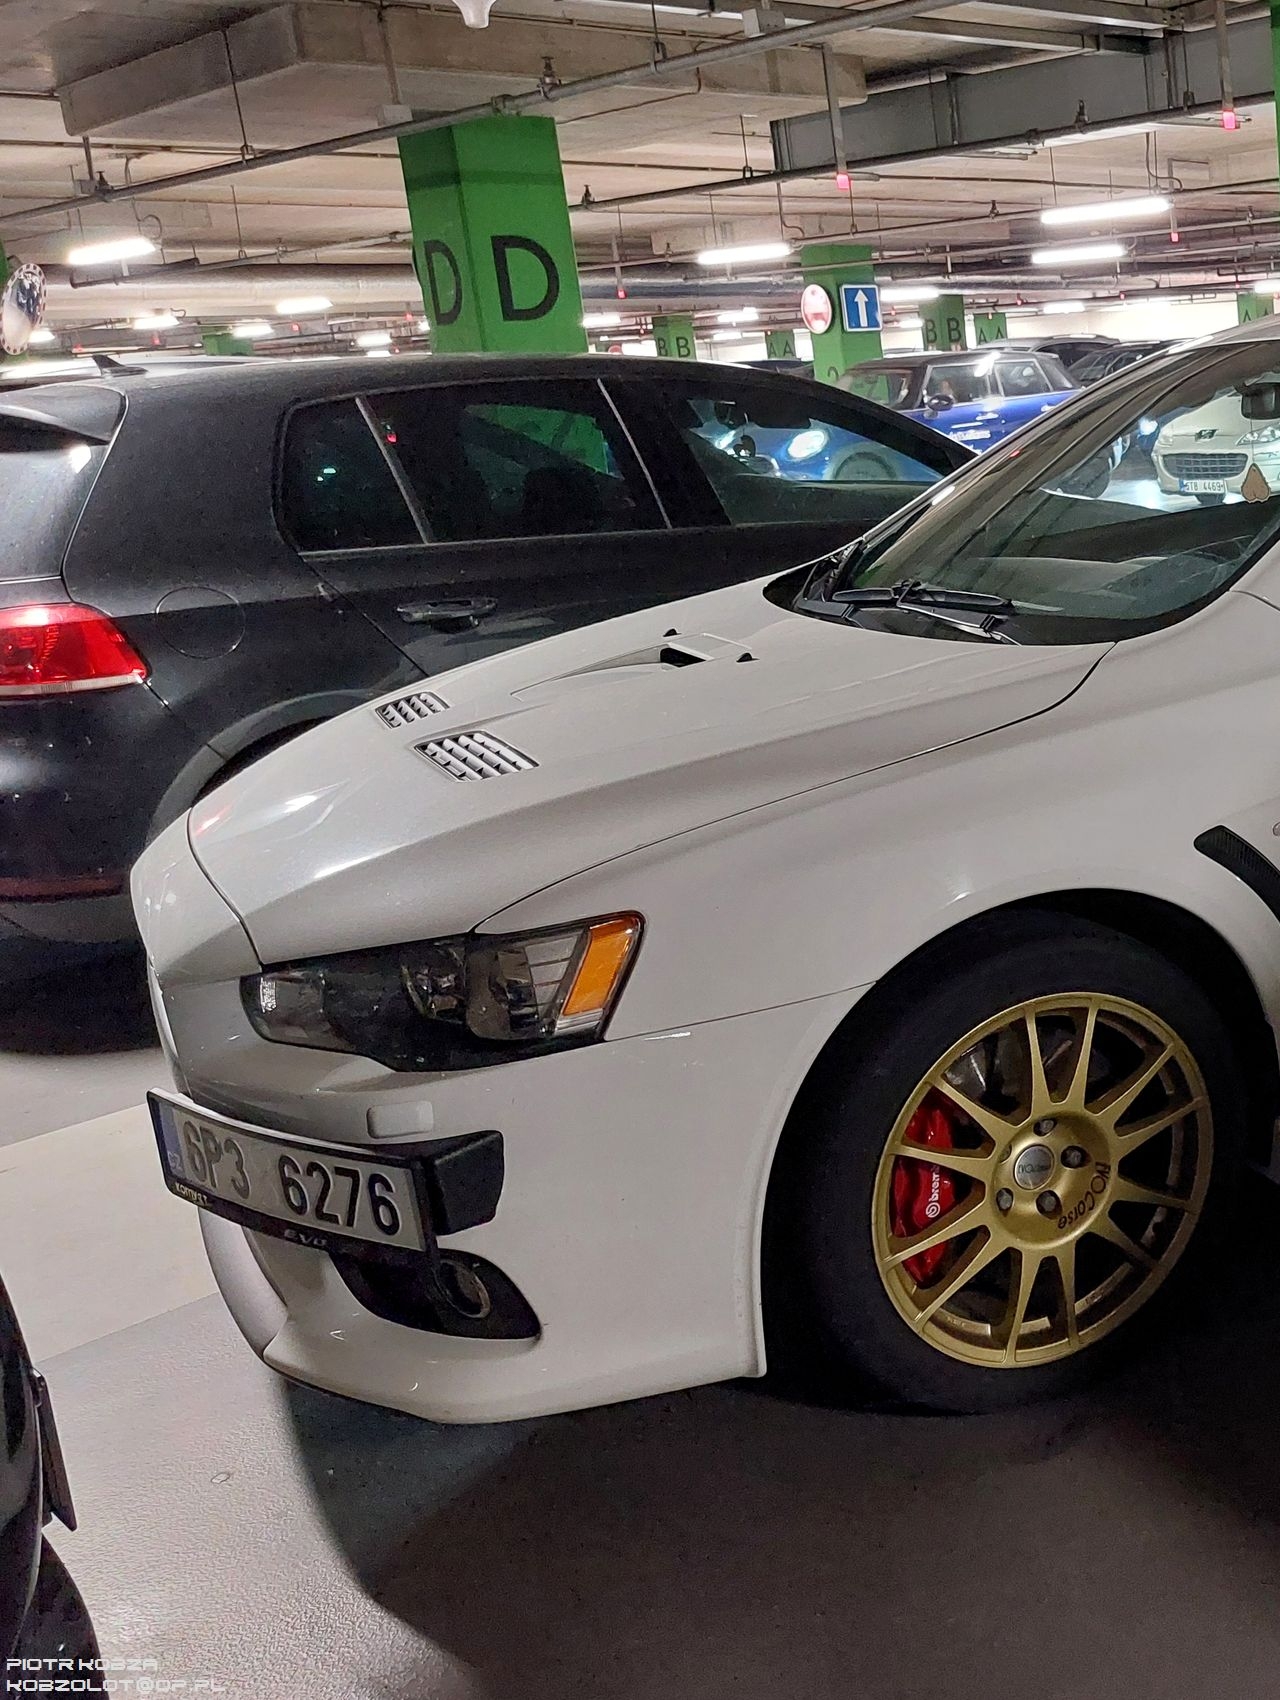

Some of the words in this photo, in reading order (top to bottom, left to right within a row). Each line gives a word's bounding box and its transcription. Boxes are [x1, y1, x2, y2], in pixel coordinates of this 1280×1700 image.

[424, 239, 462, 325] D
[491, 235, 560, 321] D
[925, 318, 937, 343] B
[947, 317, 961, 342] B
[657, 338, 668, 357] B
[676, 337, 690, 358] B
[768, 341, 778, 357] A
[783, 340, 795, 357] A
[183, 1121, 250, 1200] 6P3
[279, 1155, 401, 1236] 6276
